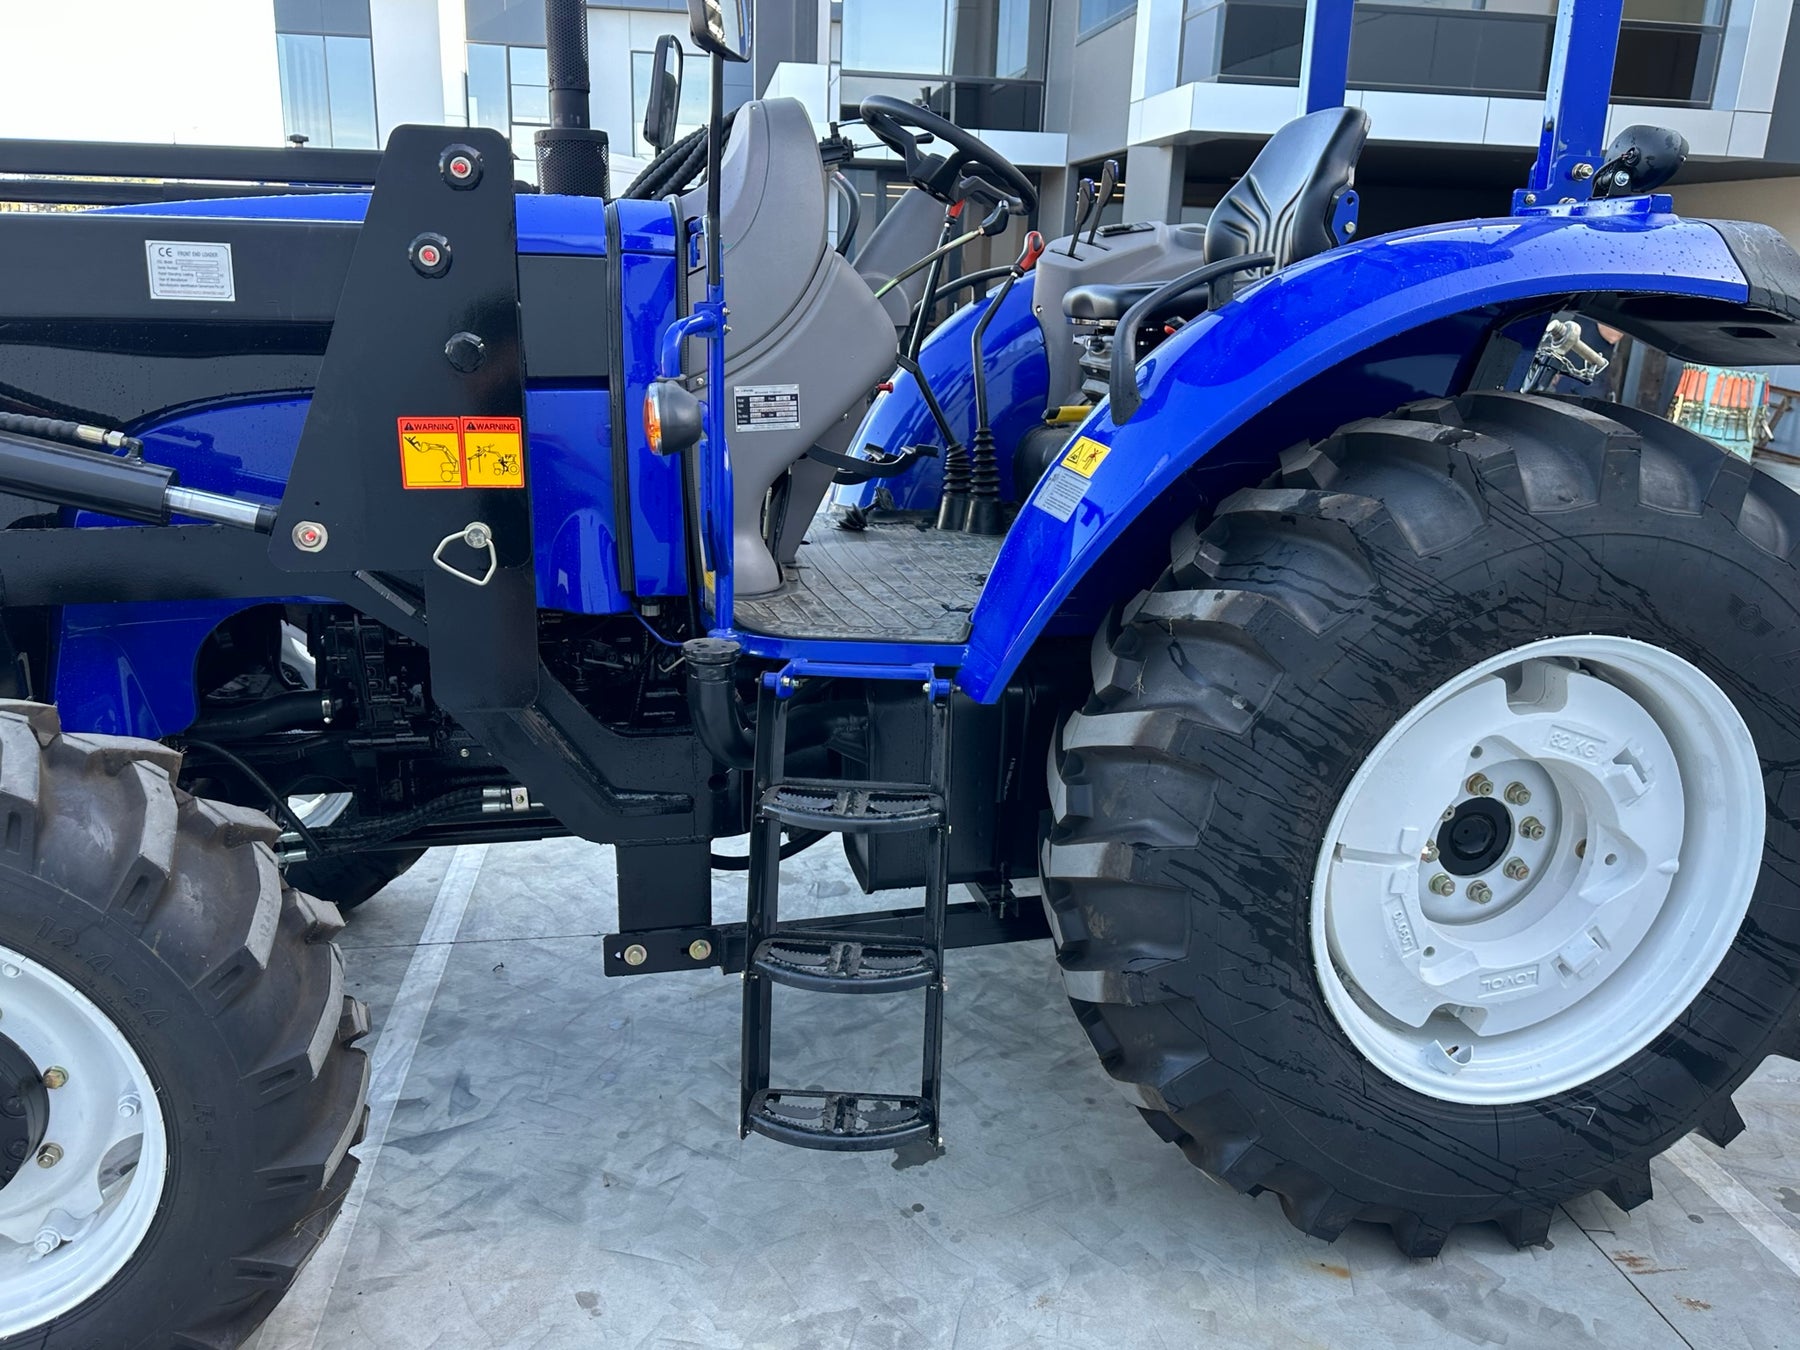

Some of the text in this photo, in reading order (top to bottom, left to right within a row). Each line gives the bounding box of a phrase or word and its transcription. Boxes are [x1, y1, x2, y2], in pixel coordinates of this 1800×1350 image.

[414, 423, 454, 431] WARNING
[476, 423, 516, 431] WARNING
[1550, 732, 1597, 758] 82 KG
[34, 914, 169, 1027] 12.4-24
[1480, 970, 1538, 992] LOVOL
